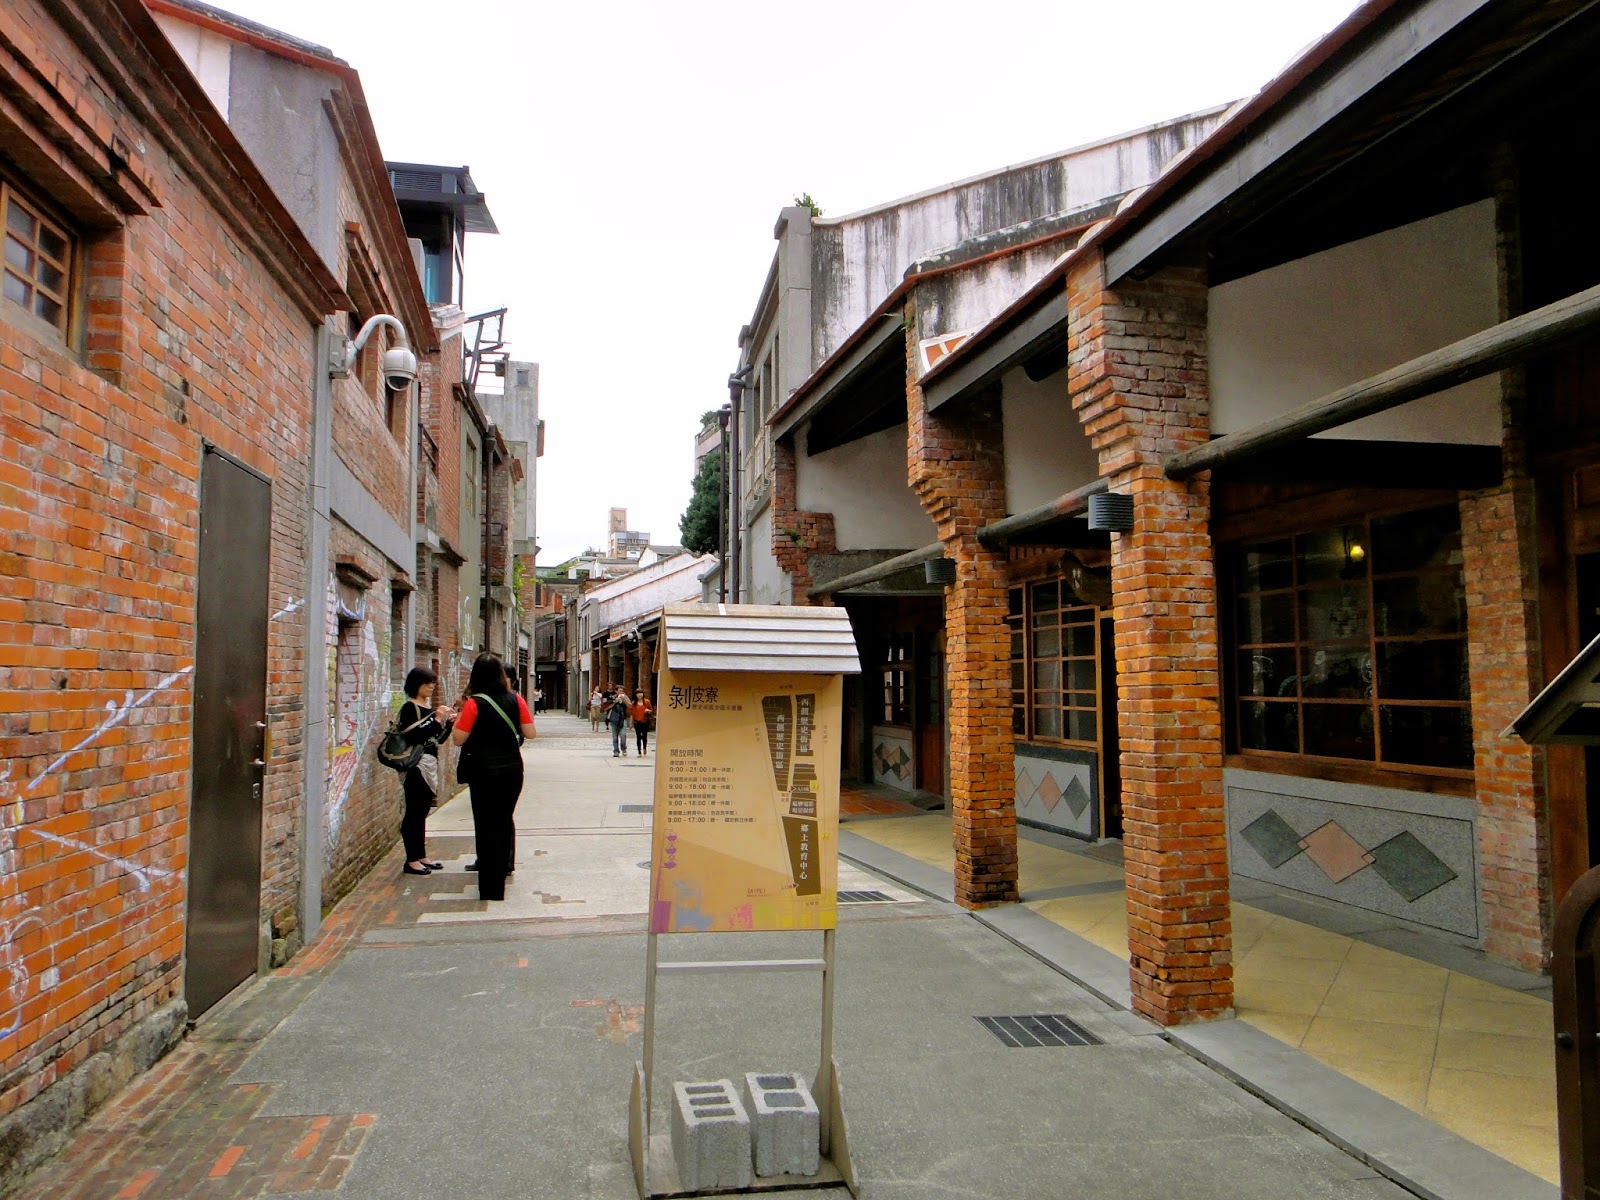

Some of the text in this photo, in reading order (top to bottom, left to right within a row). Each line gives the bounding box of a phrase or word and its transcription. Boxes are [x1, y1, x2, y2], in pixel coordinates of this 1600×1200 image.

[669, 685, 719, 709] 剝皮寮
[670, 749, 704, 757] 開放時間
[800, 824, 809, 880] 鄉土教育中心
